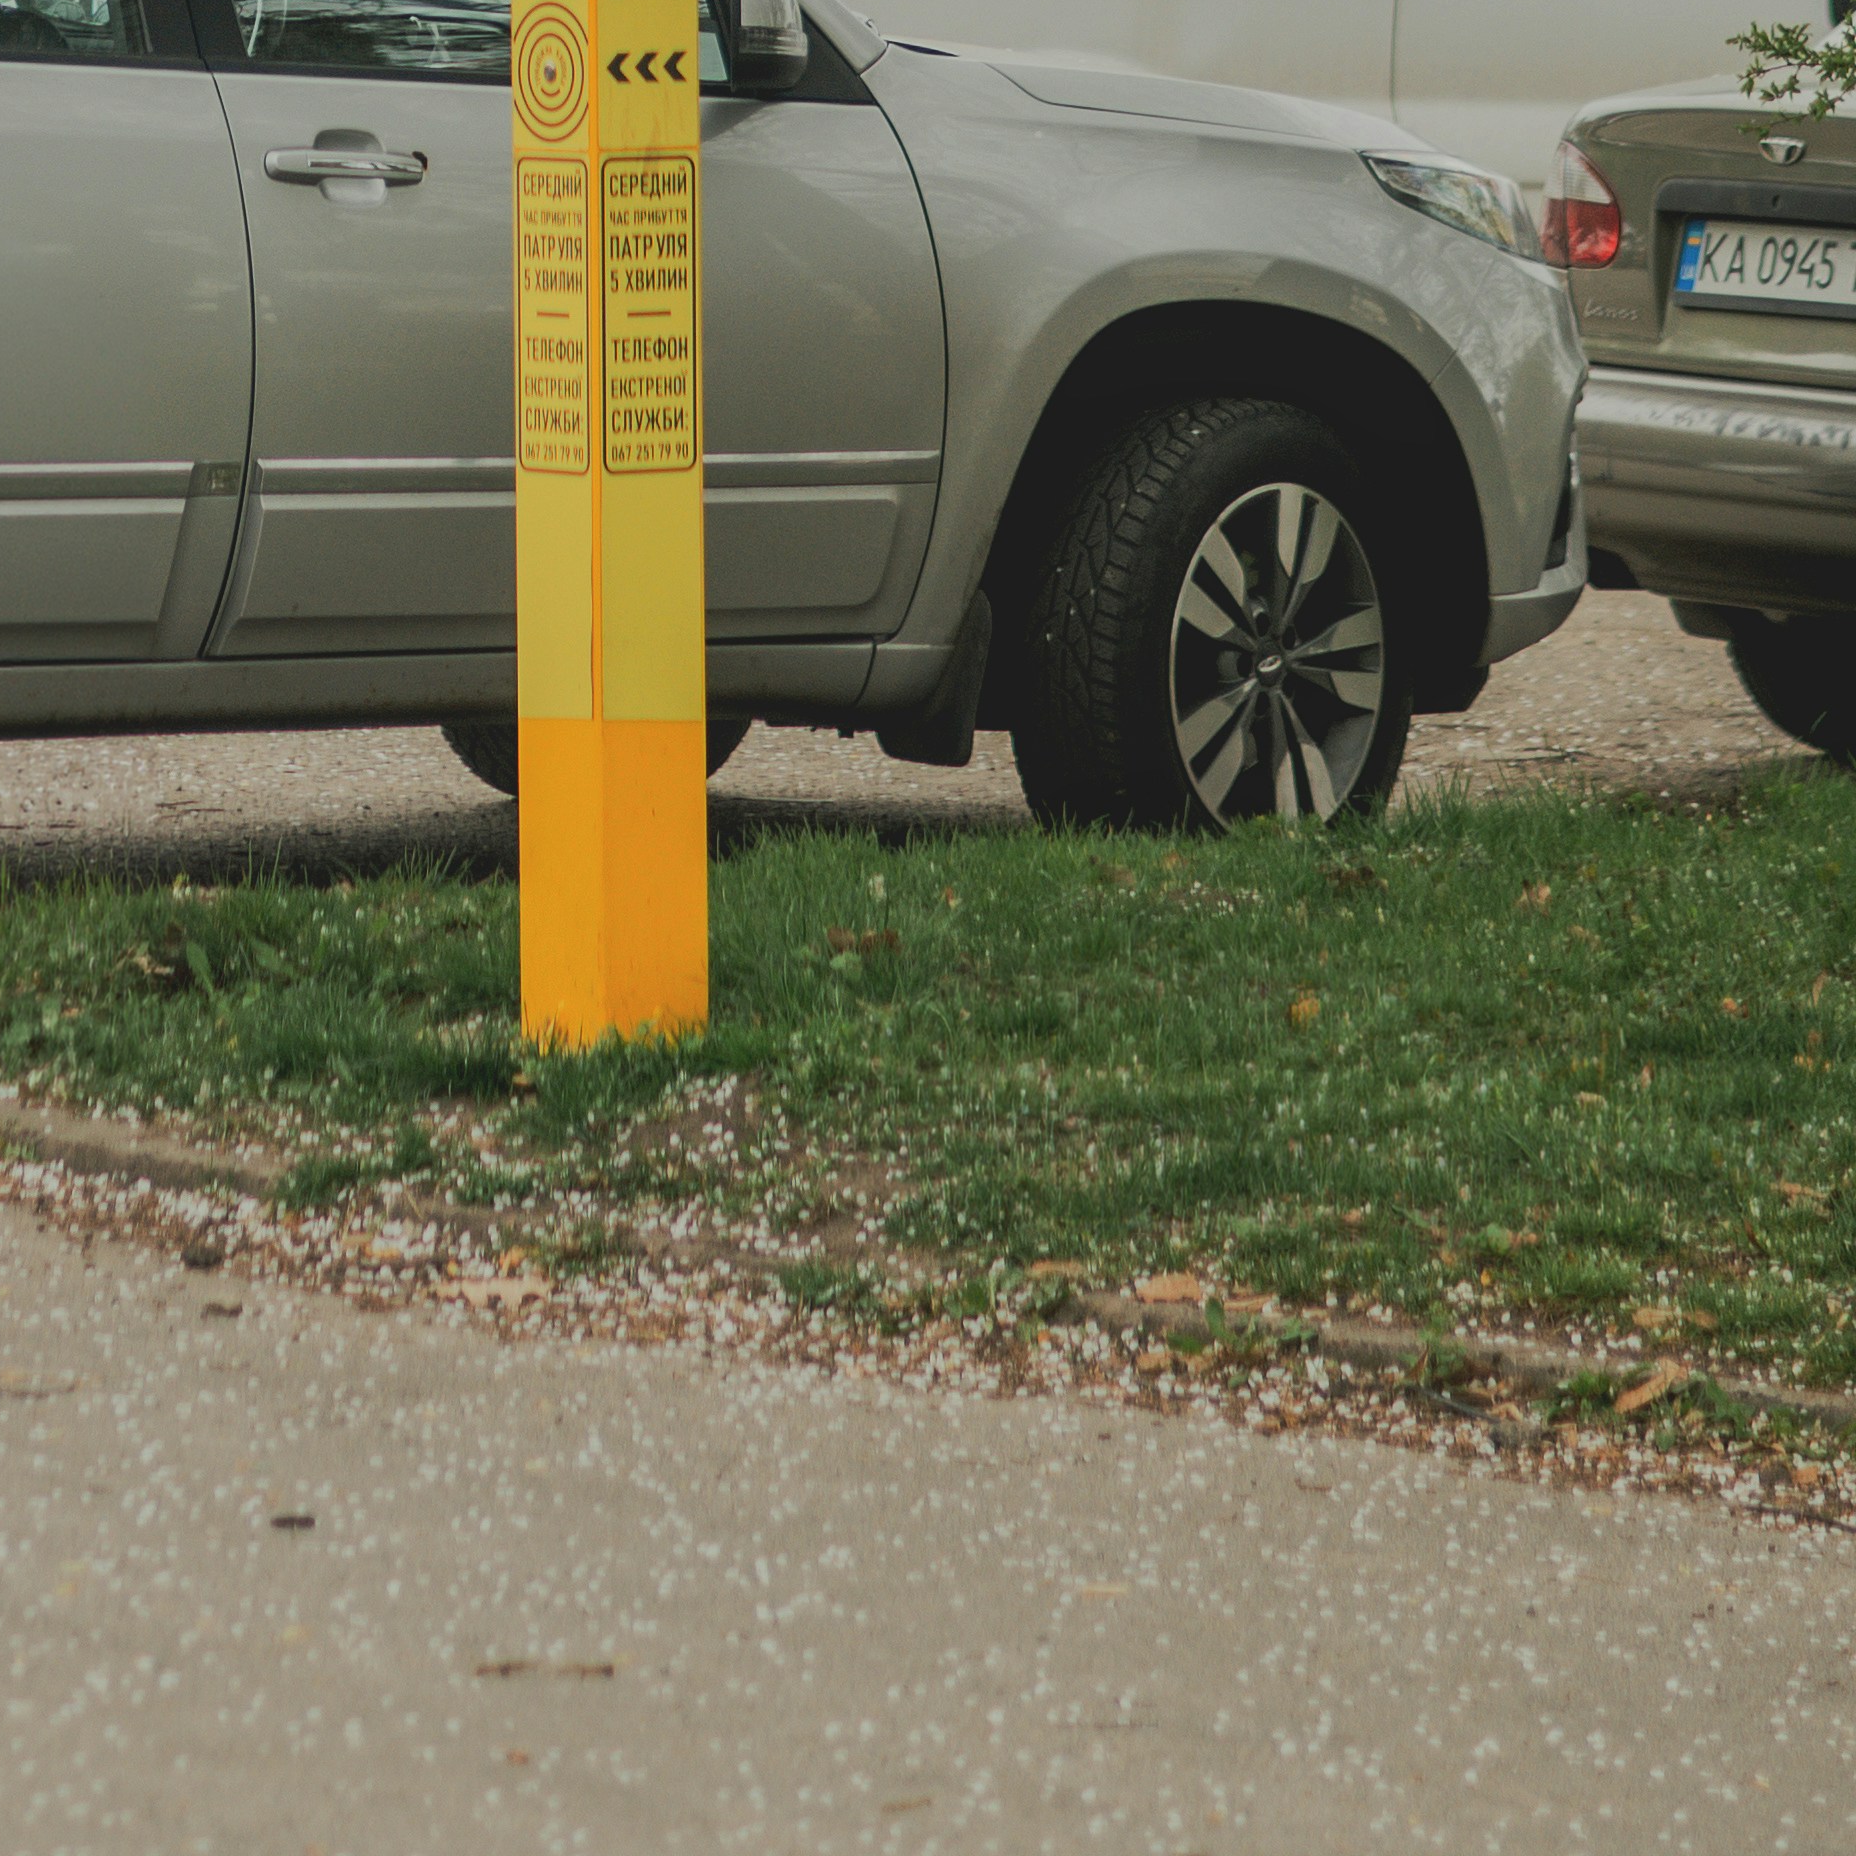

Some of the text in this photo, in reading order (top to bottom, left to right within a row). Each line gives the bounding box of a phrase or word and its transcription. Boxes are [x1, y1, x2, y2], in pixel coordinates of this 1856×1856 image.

[524, 169, 582, 201] СЕРЕДНІЙ
[610, 166, 687, 200] СЕРЕДНІЙ
[610, 208, 687, 225] ЧАС ПРИБУТТЯ
[524, 234, 582, 262] ПАТРУЛЯ
[610, 233, 687, 261] ПАТРУЛЯ
[1699, 233, 1744, 284] KA
[1758, 236, 1838, 289] 0945
[524, 268, 583, 294] 5 ХВИЛИН
[610, 267, 687, 293] 5 ХВИЛИН
[526, 336, 584, 365] ТЕЛЕФОН
[612, 336, 688, 364] ТЕЛЕФОН
[525, 374, 583, 400] ЕКСТРЕНОЇ
[611, 370, 688, 399] ЕКСТРЕНОЇ
[525, 407, 584, 436] СЛУЖБИ:
[612, 405, 689, 435] СЛУЖБИ:
[525, 443, 584, 465] 067 251 79 90
[612, 442, 689, 463] 067 251 79 90
